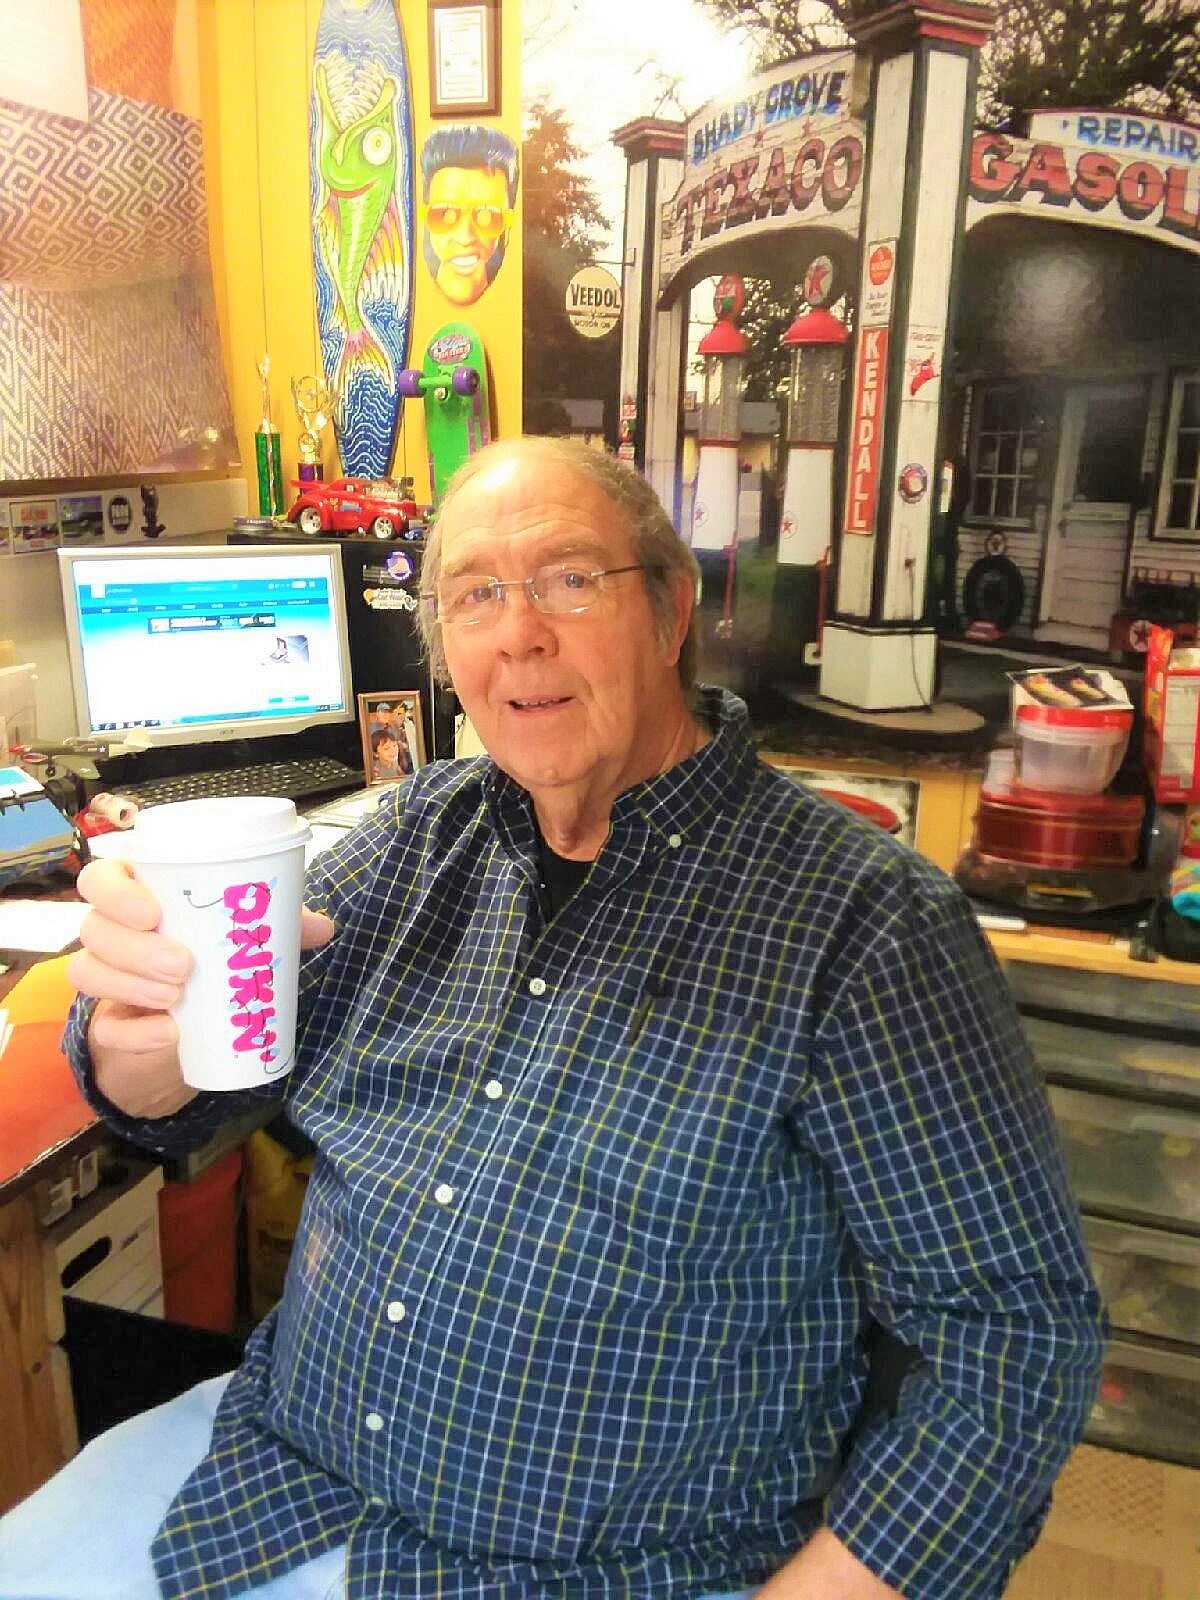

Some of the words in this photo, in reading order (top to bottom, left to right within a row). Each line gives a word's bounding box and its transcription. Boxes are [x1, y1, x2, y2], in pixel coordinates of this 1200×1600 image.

[691, 97, 757, 166] SHADY
[765, 72, 848, 123] GROVE
[675, 135, 864, 257] TEXACO
[571, 284, 620, 309] VEEDOL
[852, 330, 881, 529] KENDALL
